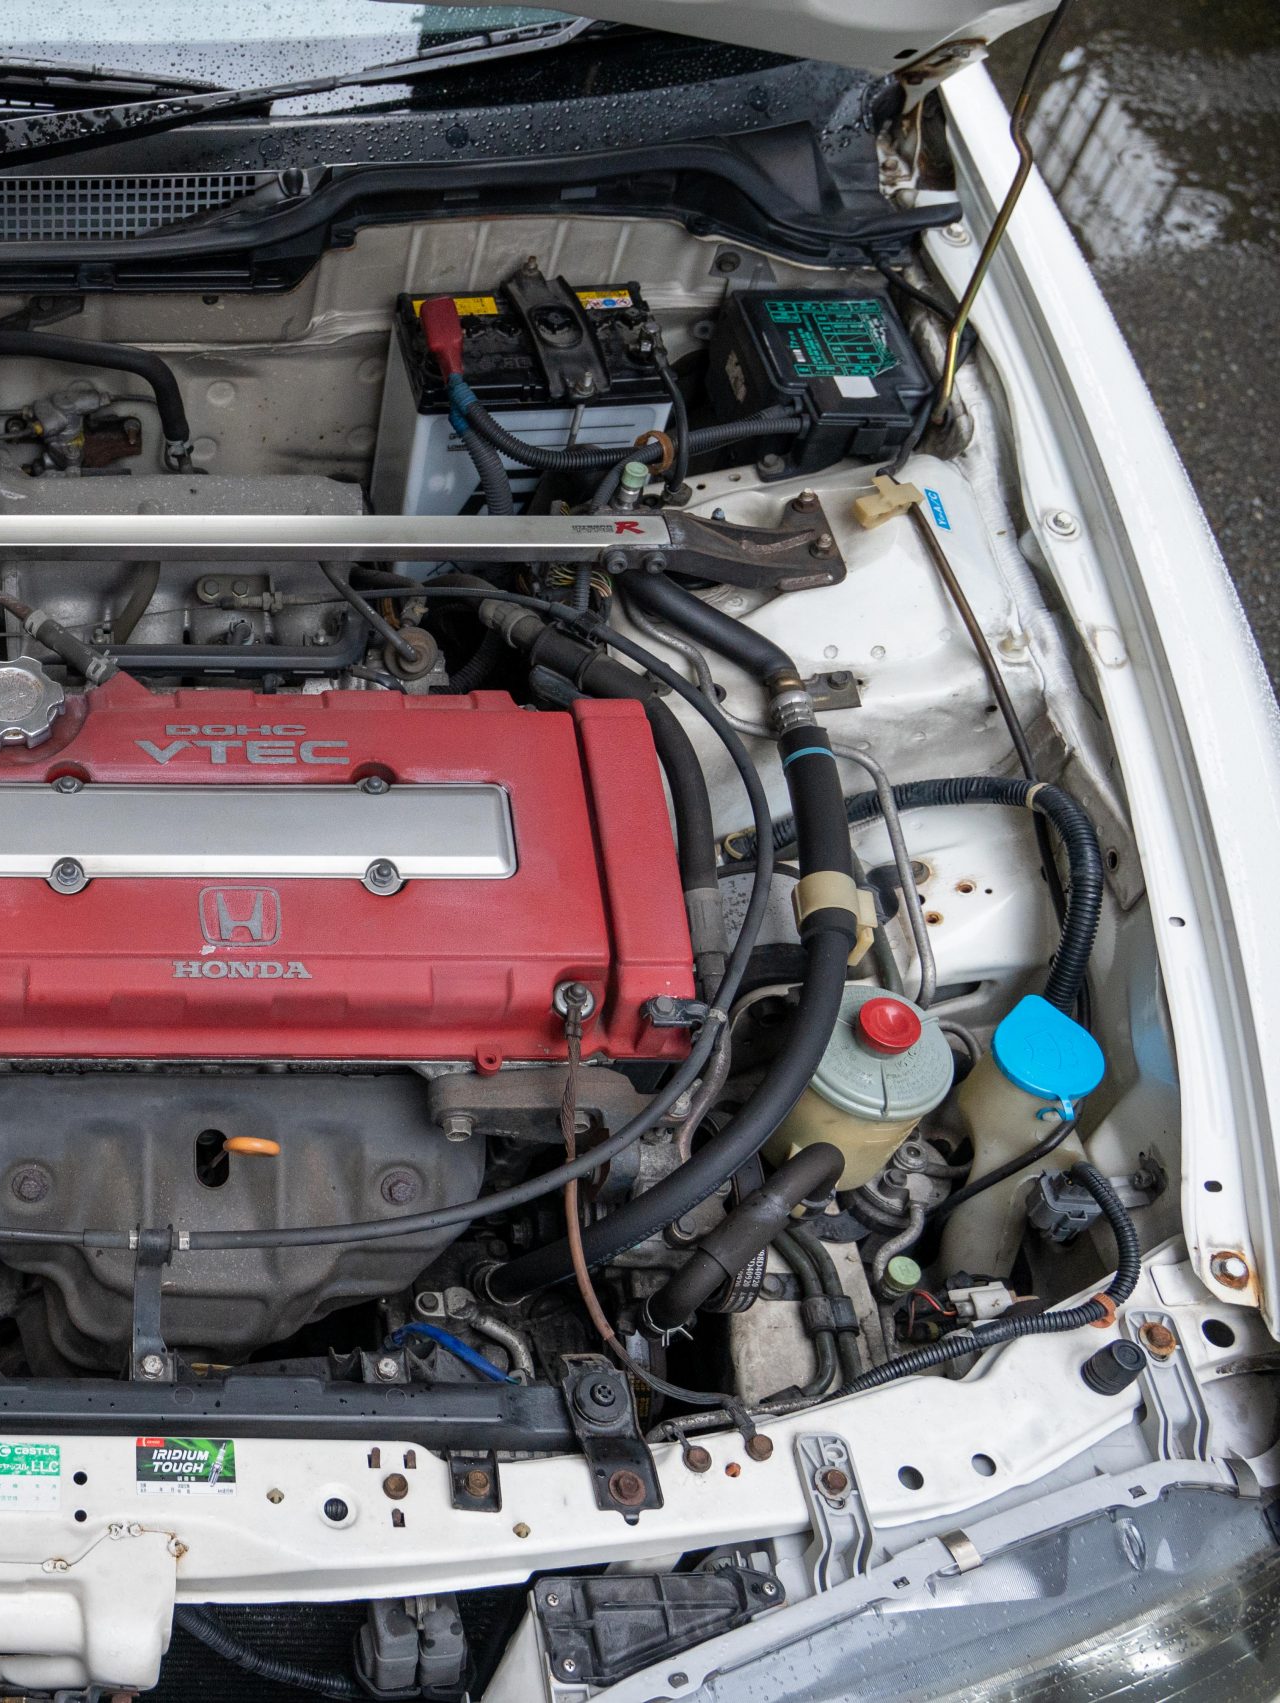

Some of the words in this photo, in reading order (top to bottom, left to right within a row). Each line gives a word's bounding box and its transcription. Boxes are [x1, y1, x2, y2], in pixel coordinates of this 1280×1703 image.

[614, 521, 646, 534] R
[165, 724, 306, 736] DOHC
[134, 740, 350, 765] VTEC
[172, 960, 313, 979] HONDA
[152, 1449, 209, 1460] IRIDIUM
[31, 1460, 59, 1473] LLC
[152, 1461, 205, 1473] TOUGH
